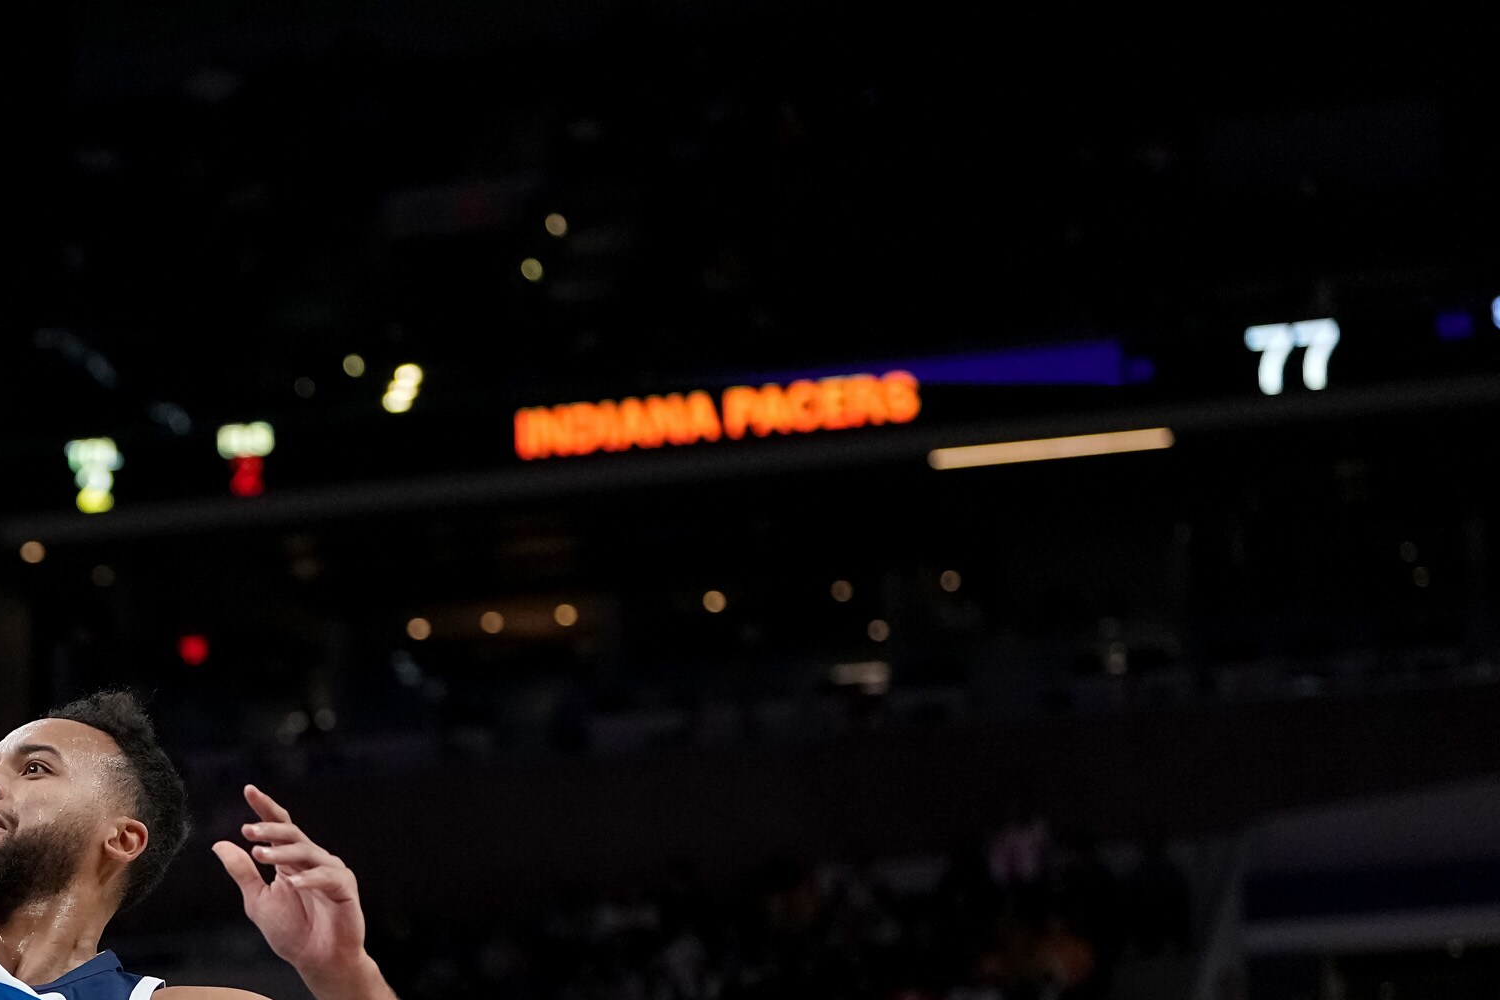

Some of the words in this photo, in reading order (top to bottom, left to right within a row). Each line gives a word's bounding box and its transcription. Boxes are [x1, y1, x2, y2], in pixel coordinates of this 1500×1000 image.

[1244, 317, 1341, 396] 77
[515, 390, 720, 460] INDIANA
[721, 369, 922, 441] PACERS
